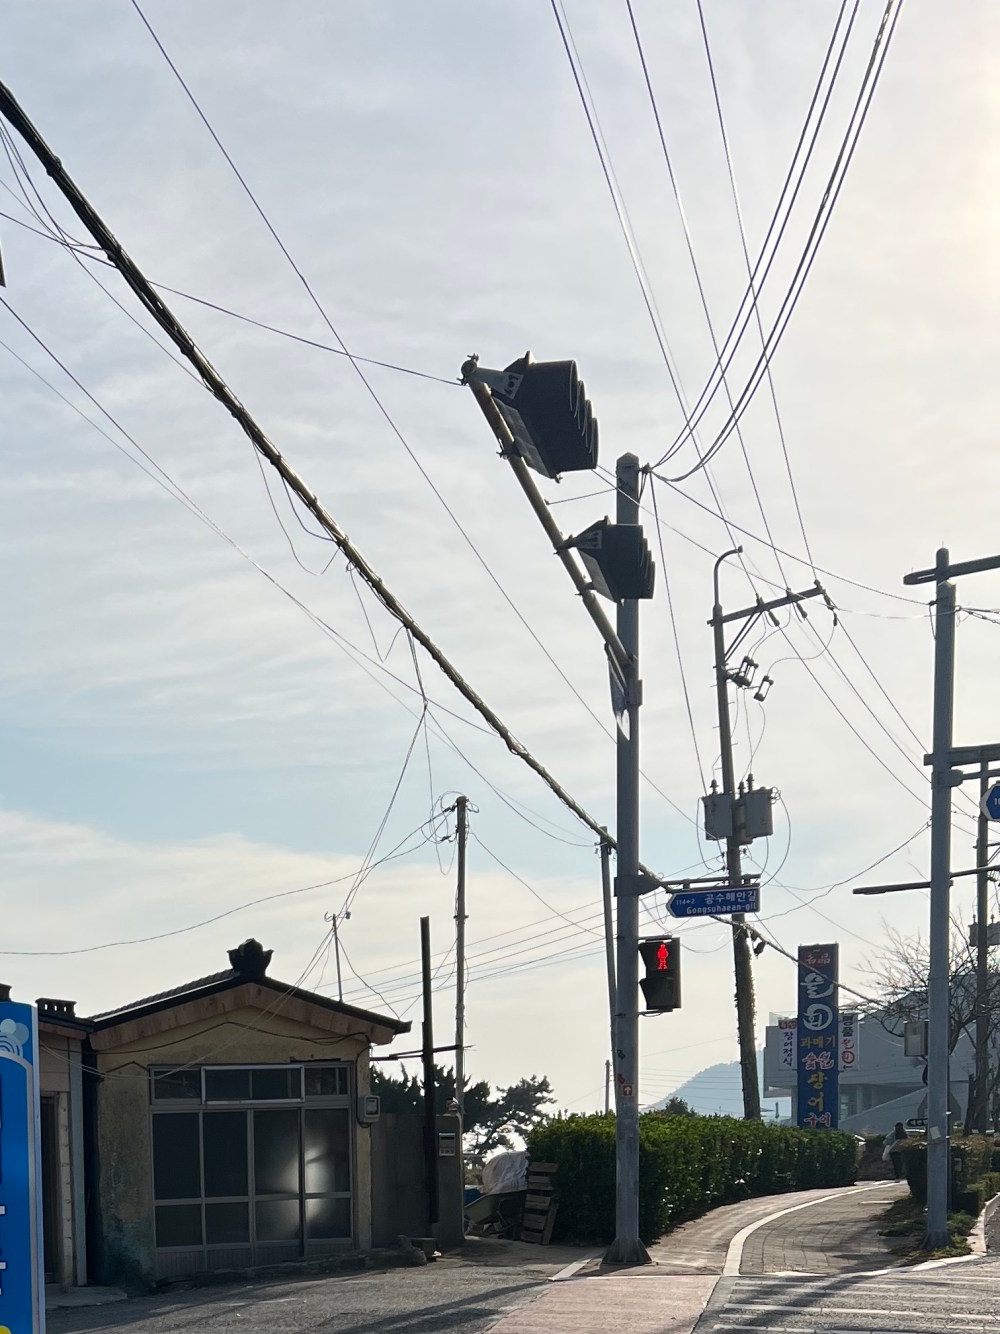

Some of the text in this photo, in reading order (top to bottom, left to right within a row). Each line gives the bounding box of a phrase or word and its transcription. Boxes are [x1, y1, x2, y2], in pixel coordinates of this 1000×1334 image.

[704, 890, 757, 905] 공수해안길
[686, 903, 757, 915] Gongsuhaean-gil
[783, 1031, 795, 1067] 장어정식
[800, 1036, 836, 1049] 과메기
